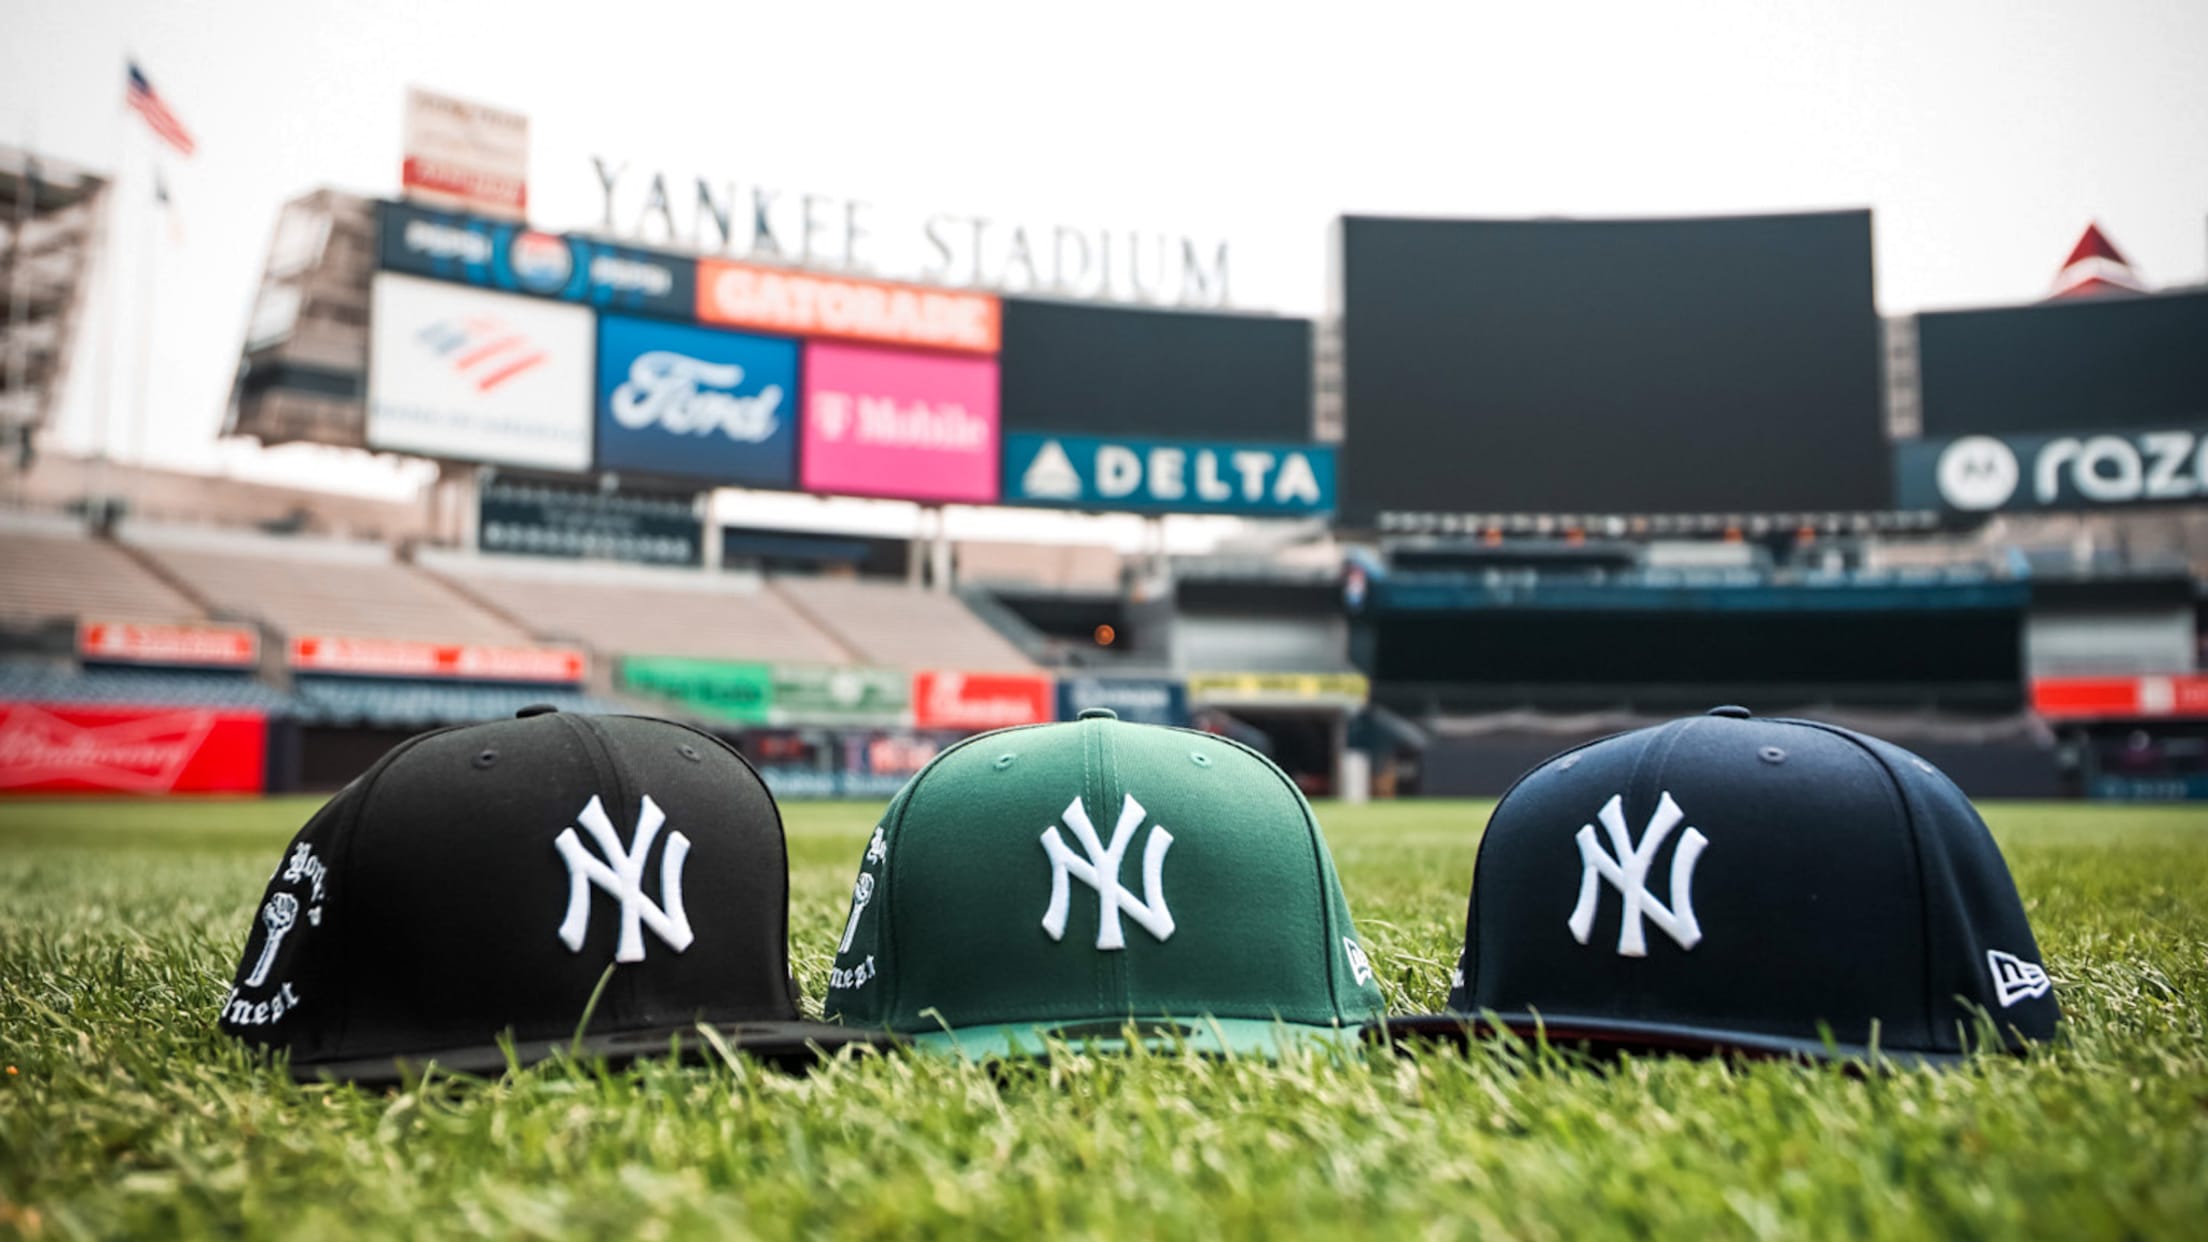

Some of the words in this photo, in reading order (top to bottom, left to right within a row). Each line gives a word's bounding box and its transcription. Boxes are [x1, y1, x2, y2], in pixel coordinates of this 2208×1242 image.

[588, 153, 874, 268] YANKEE
[922, 210, 1229, 309] STADIUM
[714, 268, 990, 343] GATORADE
[611, 350, 784, 443] Ford
[1095, 445, 1320, 503] DELTA
[555, 795, 694, 961] NY
[1040, 793, 1175, 949] NY
[1568, 791, 1709, 957] NY
